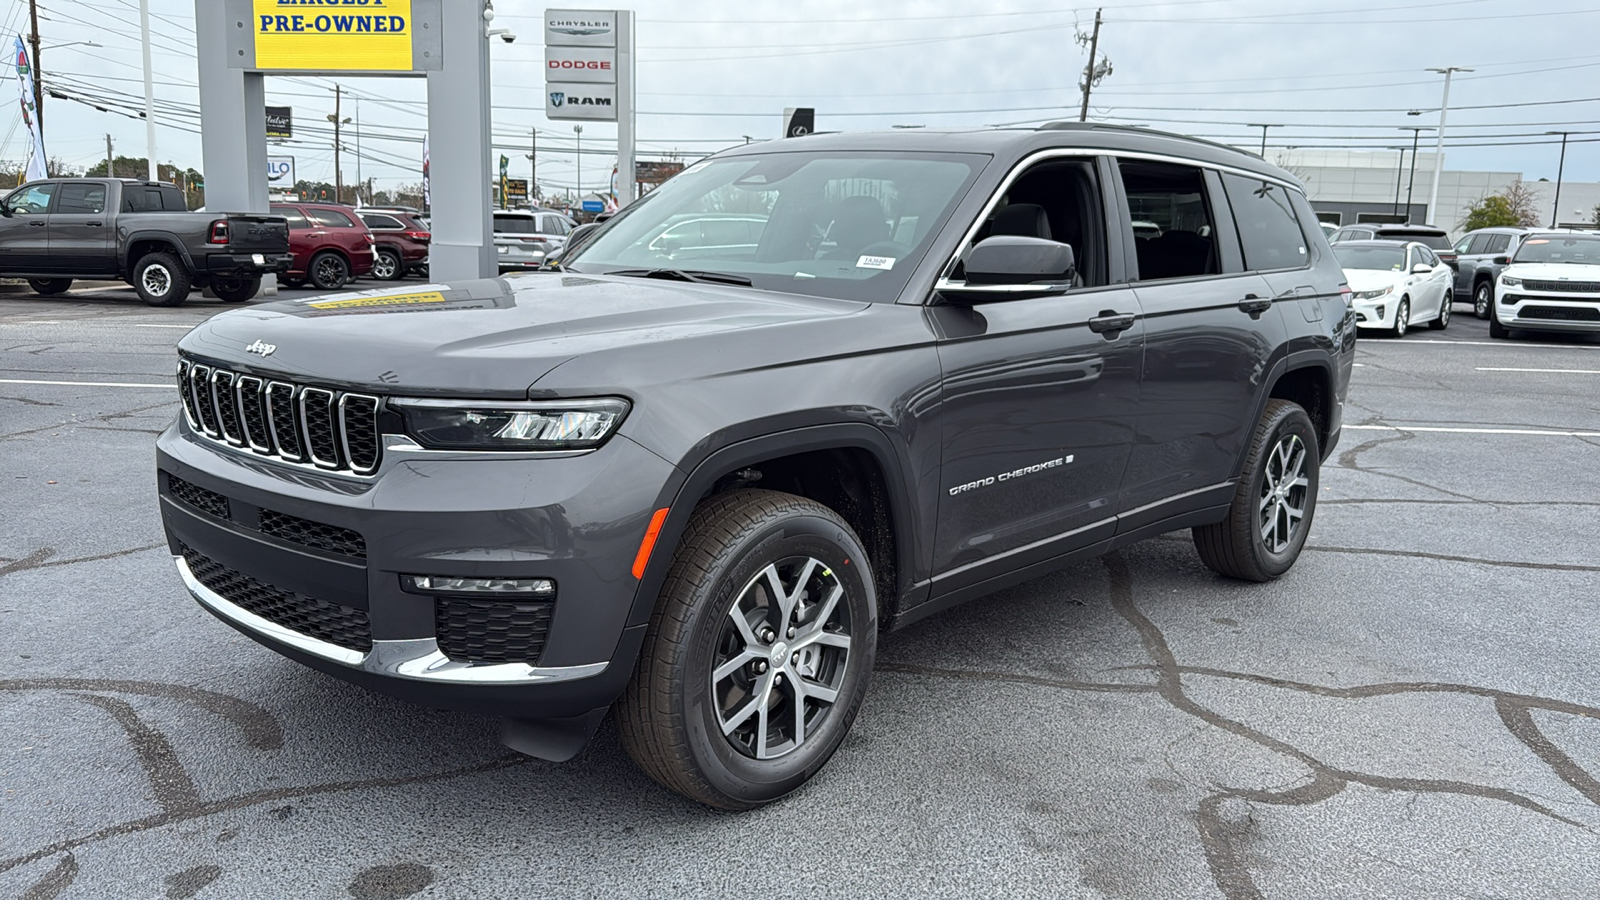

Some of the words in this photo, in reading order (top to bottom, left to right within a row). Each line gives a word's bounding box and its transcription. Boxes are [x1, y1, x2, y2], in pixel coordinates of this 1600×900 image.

[259, 14, 406, 32] PRE-OWNED
[548, 60, 612, 70] DODGE
[567, 96, 612, 106] RAM
[245, 339, 277, 358] Jeep
[949, 476, 995, 496] GRAND
[997, 457, 1064, 482] CHEROKEE
